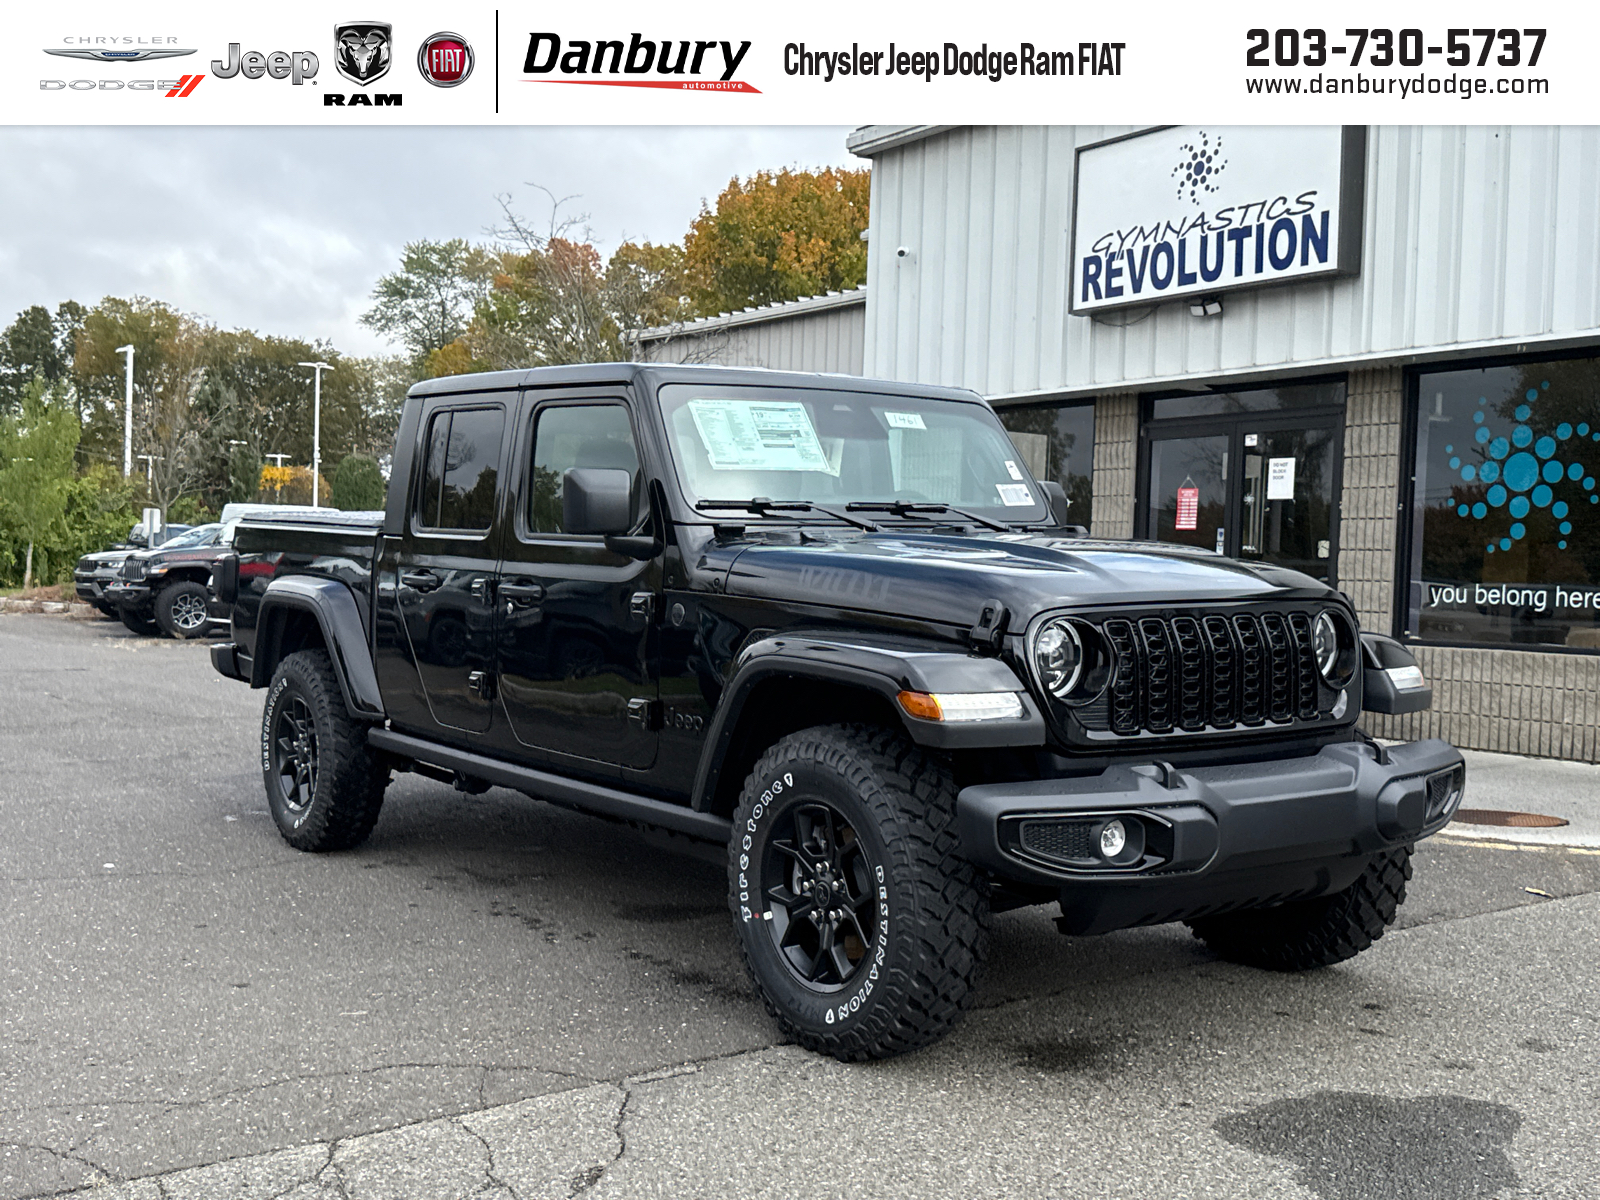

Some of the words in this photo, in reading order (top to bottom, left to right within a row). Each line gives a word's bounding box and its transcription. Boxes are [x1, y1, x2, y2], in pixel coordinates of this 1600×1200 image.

[1081, 210, 1330, 302] REVOLUTION
[1091, 190, 1318, 260] GYMNASTICS
[1429, 586, 1467, 608] you
[1475, 584, 1547, 612] belong
[664, 706, 704, 735] Jeep
[837, 865, 889, 1022] DESTINATION
